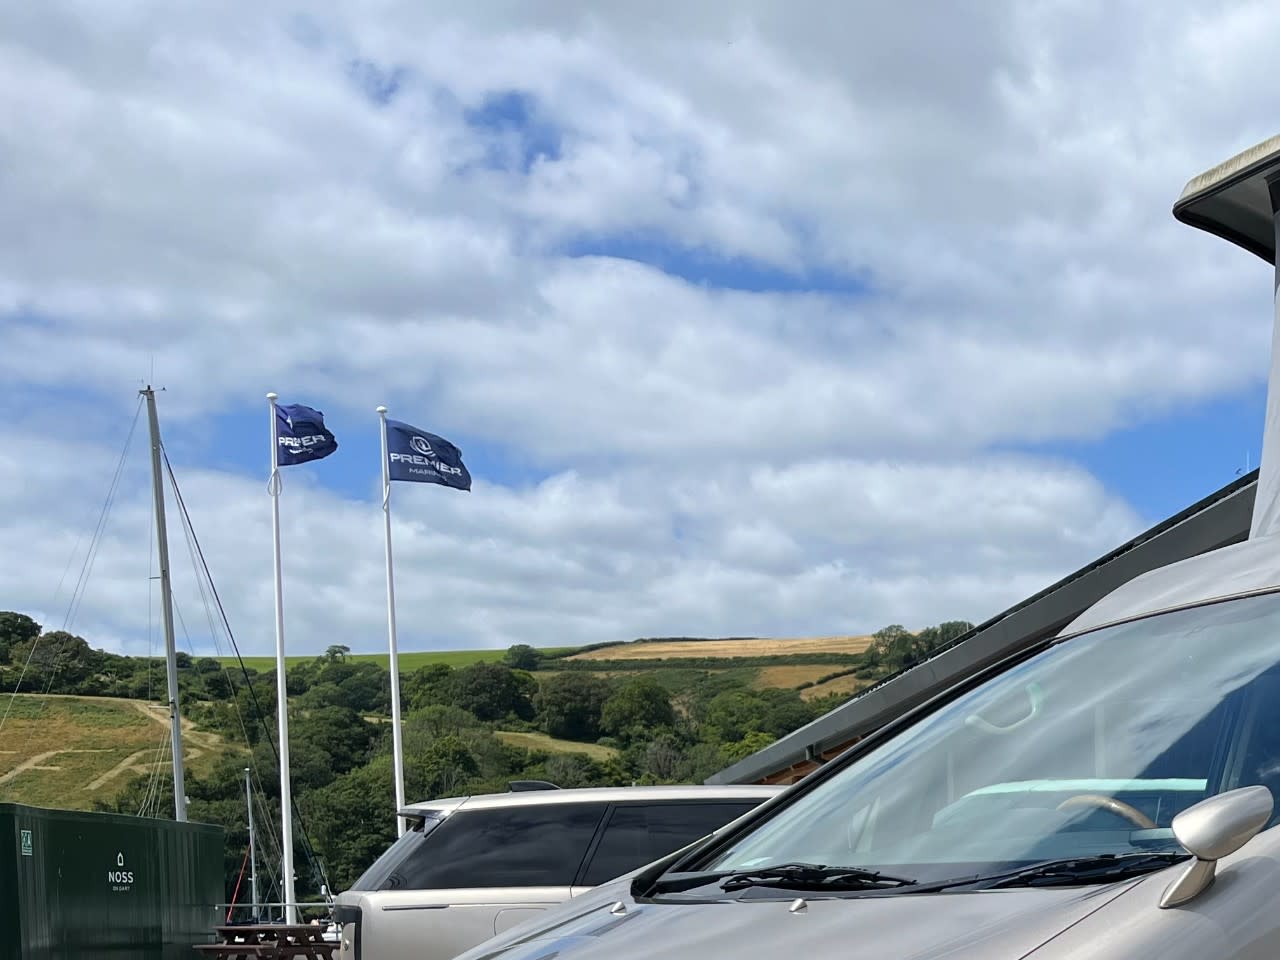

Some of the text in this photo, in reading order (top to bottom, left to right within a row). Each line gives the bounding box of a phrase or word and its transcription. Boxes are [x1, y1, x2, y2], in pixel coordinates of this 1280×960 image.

[278, 434, 326, 447] PRER
[389, 452, 462, 476] PREMIER
[408, 468, 448, 481] MARIN
[108, 871, 134, 883] NOSS
